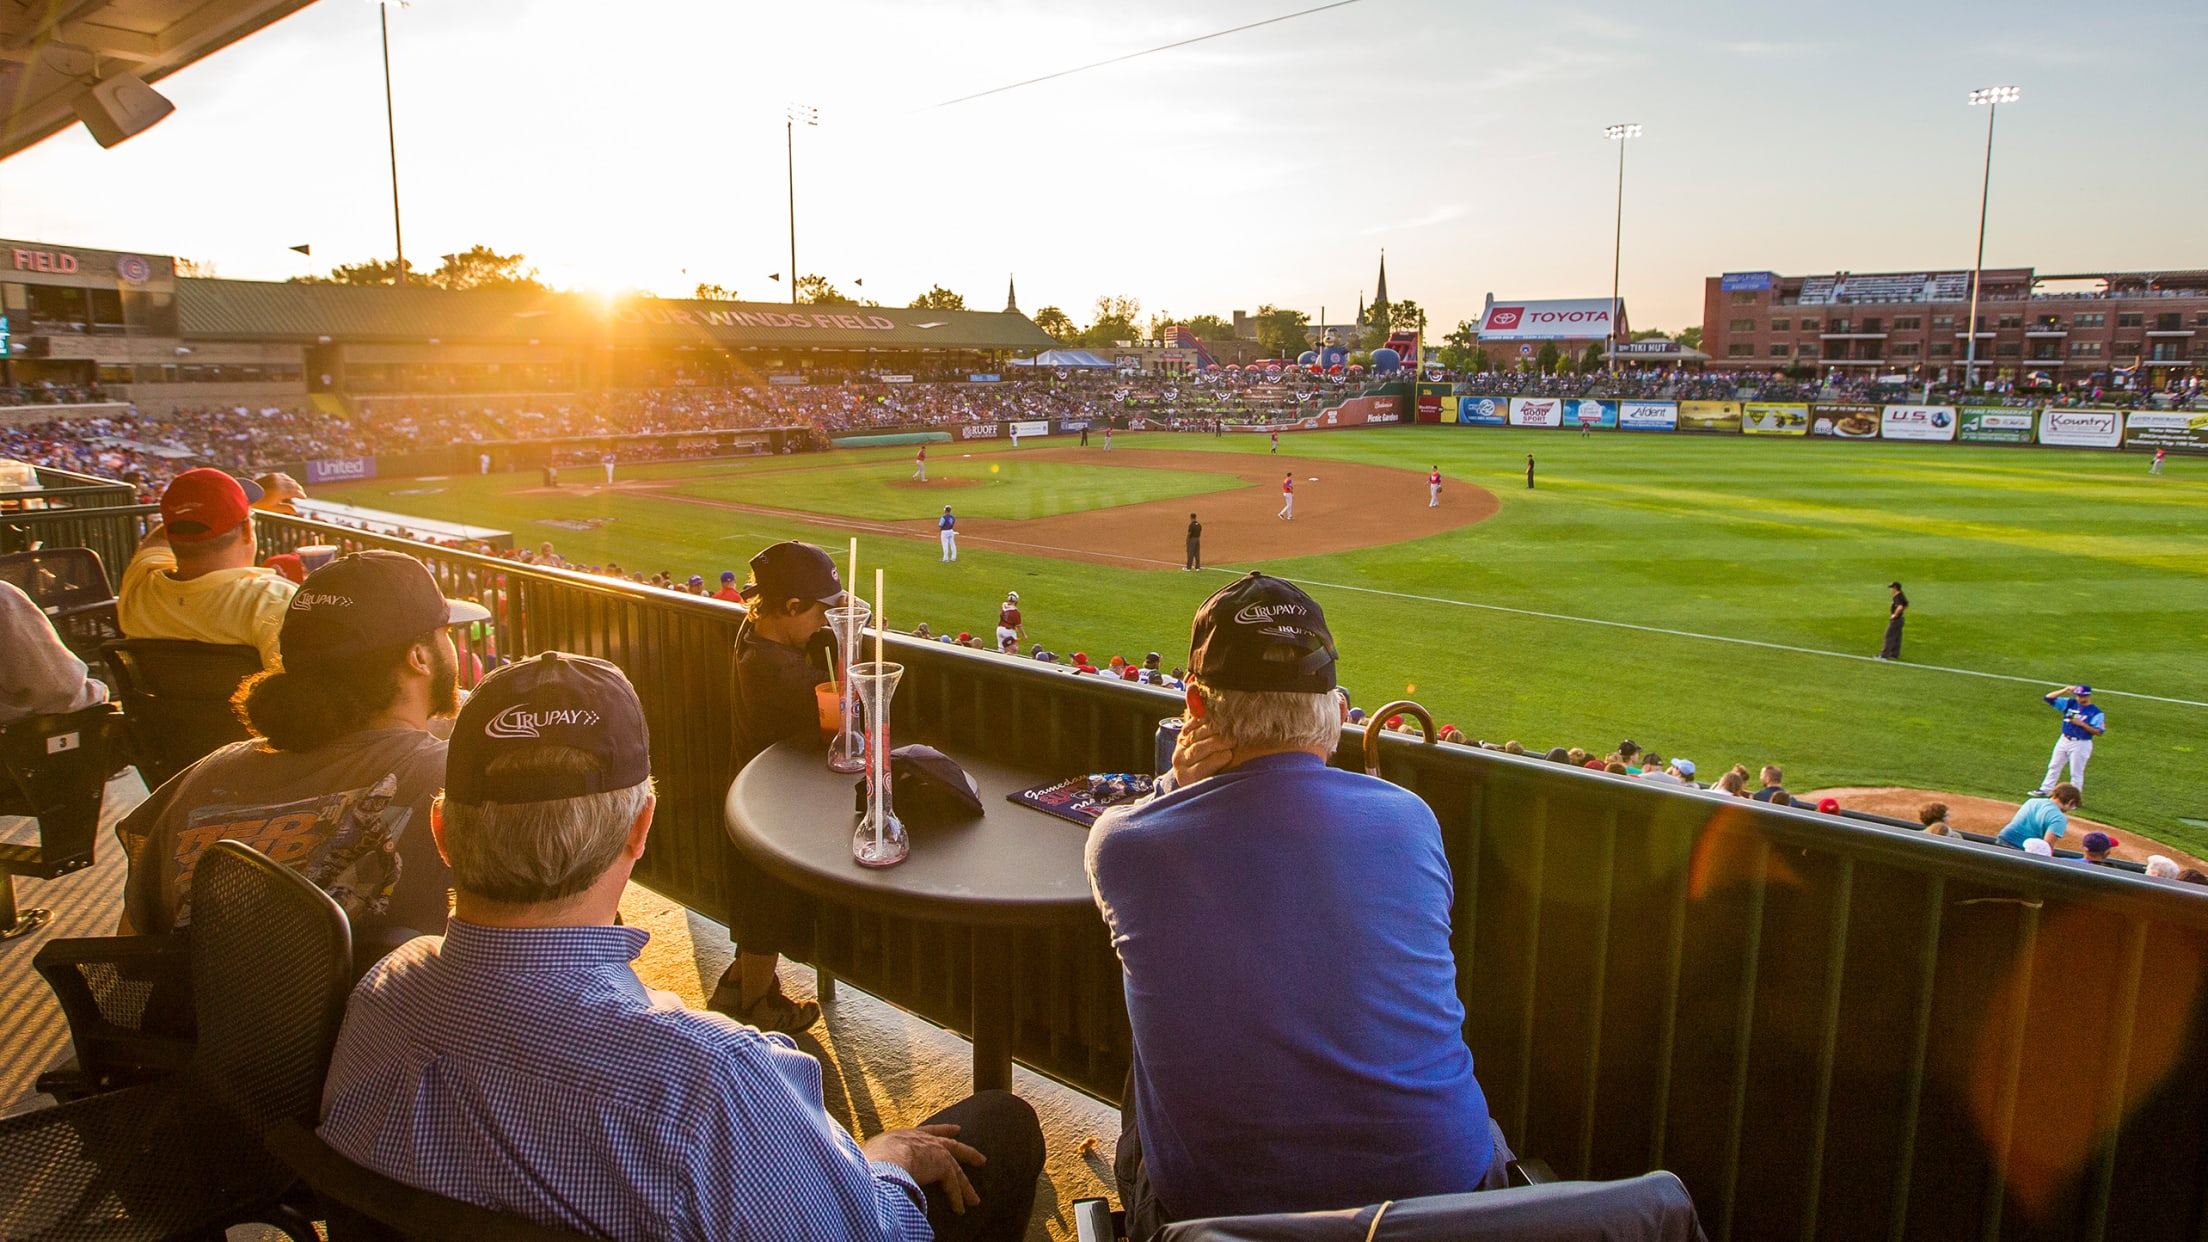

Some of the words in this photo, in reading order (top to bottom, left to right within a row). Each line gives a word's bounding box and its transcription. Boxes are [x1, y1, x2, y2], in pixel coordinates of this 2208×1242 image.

[13, 249, 79, 274] FIELD
[697, 309, 813, 329] WINDS
[810, 313, 895, 331] FIELD
[1530, 311, 1609, 323] TOYOTA
[1630, 343, 1647, 352] TIKI
[1648, 343, 1667, 352] HUT
[1367, 413, 1382, 423] Picnic
[1383, 413, 1399, 422] Garden
[2050, 414, 2111, 432] Kountry
[972, 425, 998, 435] RUOFF
[316, 458, 365, 476] United
[302, 592, 339, 605] TRUPAY
[1252, 604, 1297, 618] TRUPAY
[509, 709, 583, 730] TRUPAY
[59, 737, 67, 748] 3
[1024, 774, 1088, 800] Gameday
